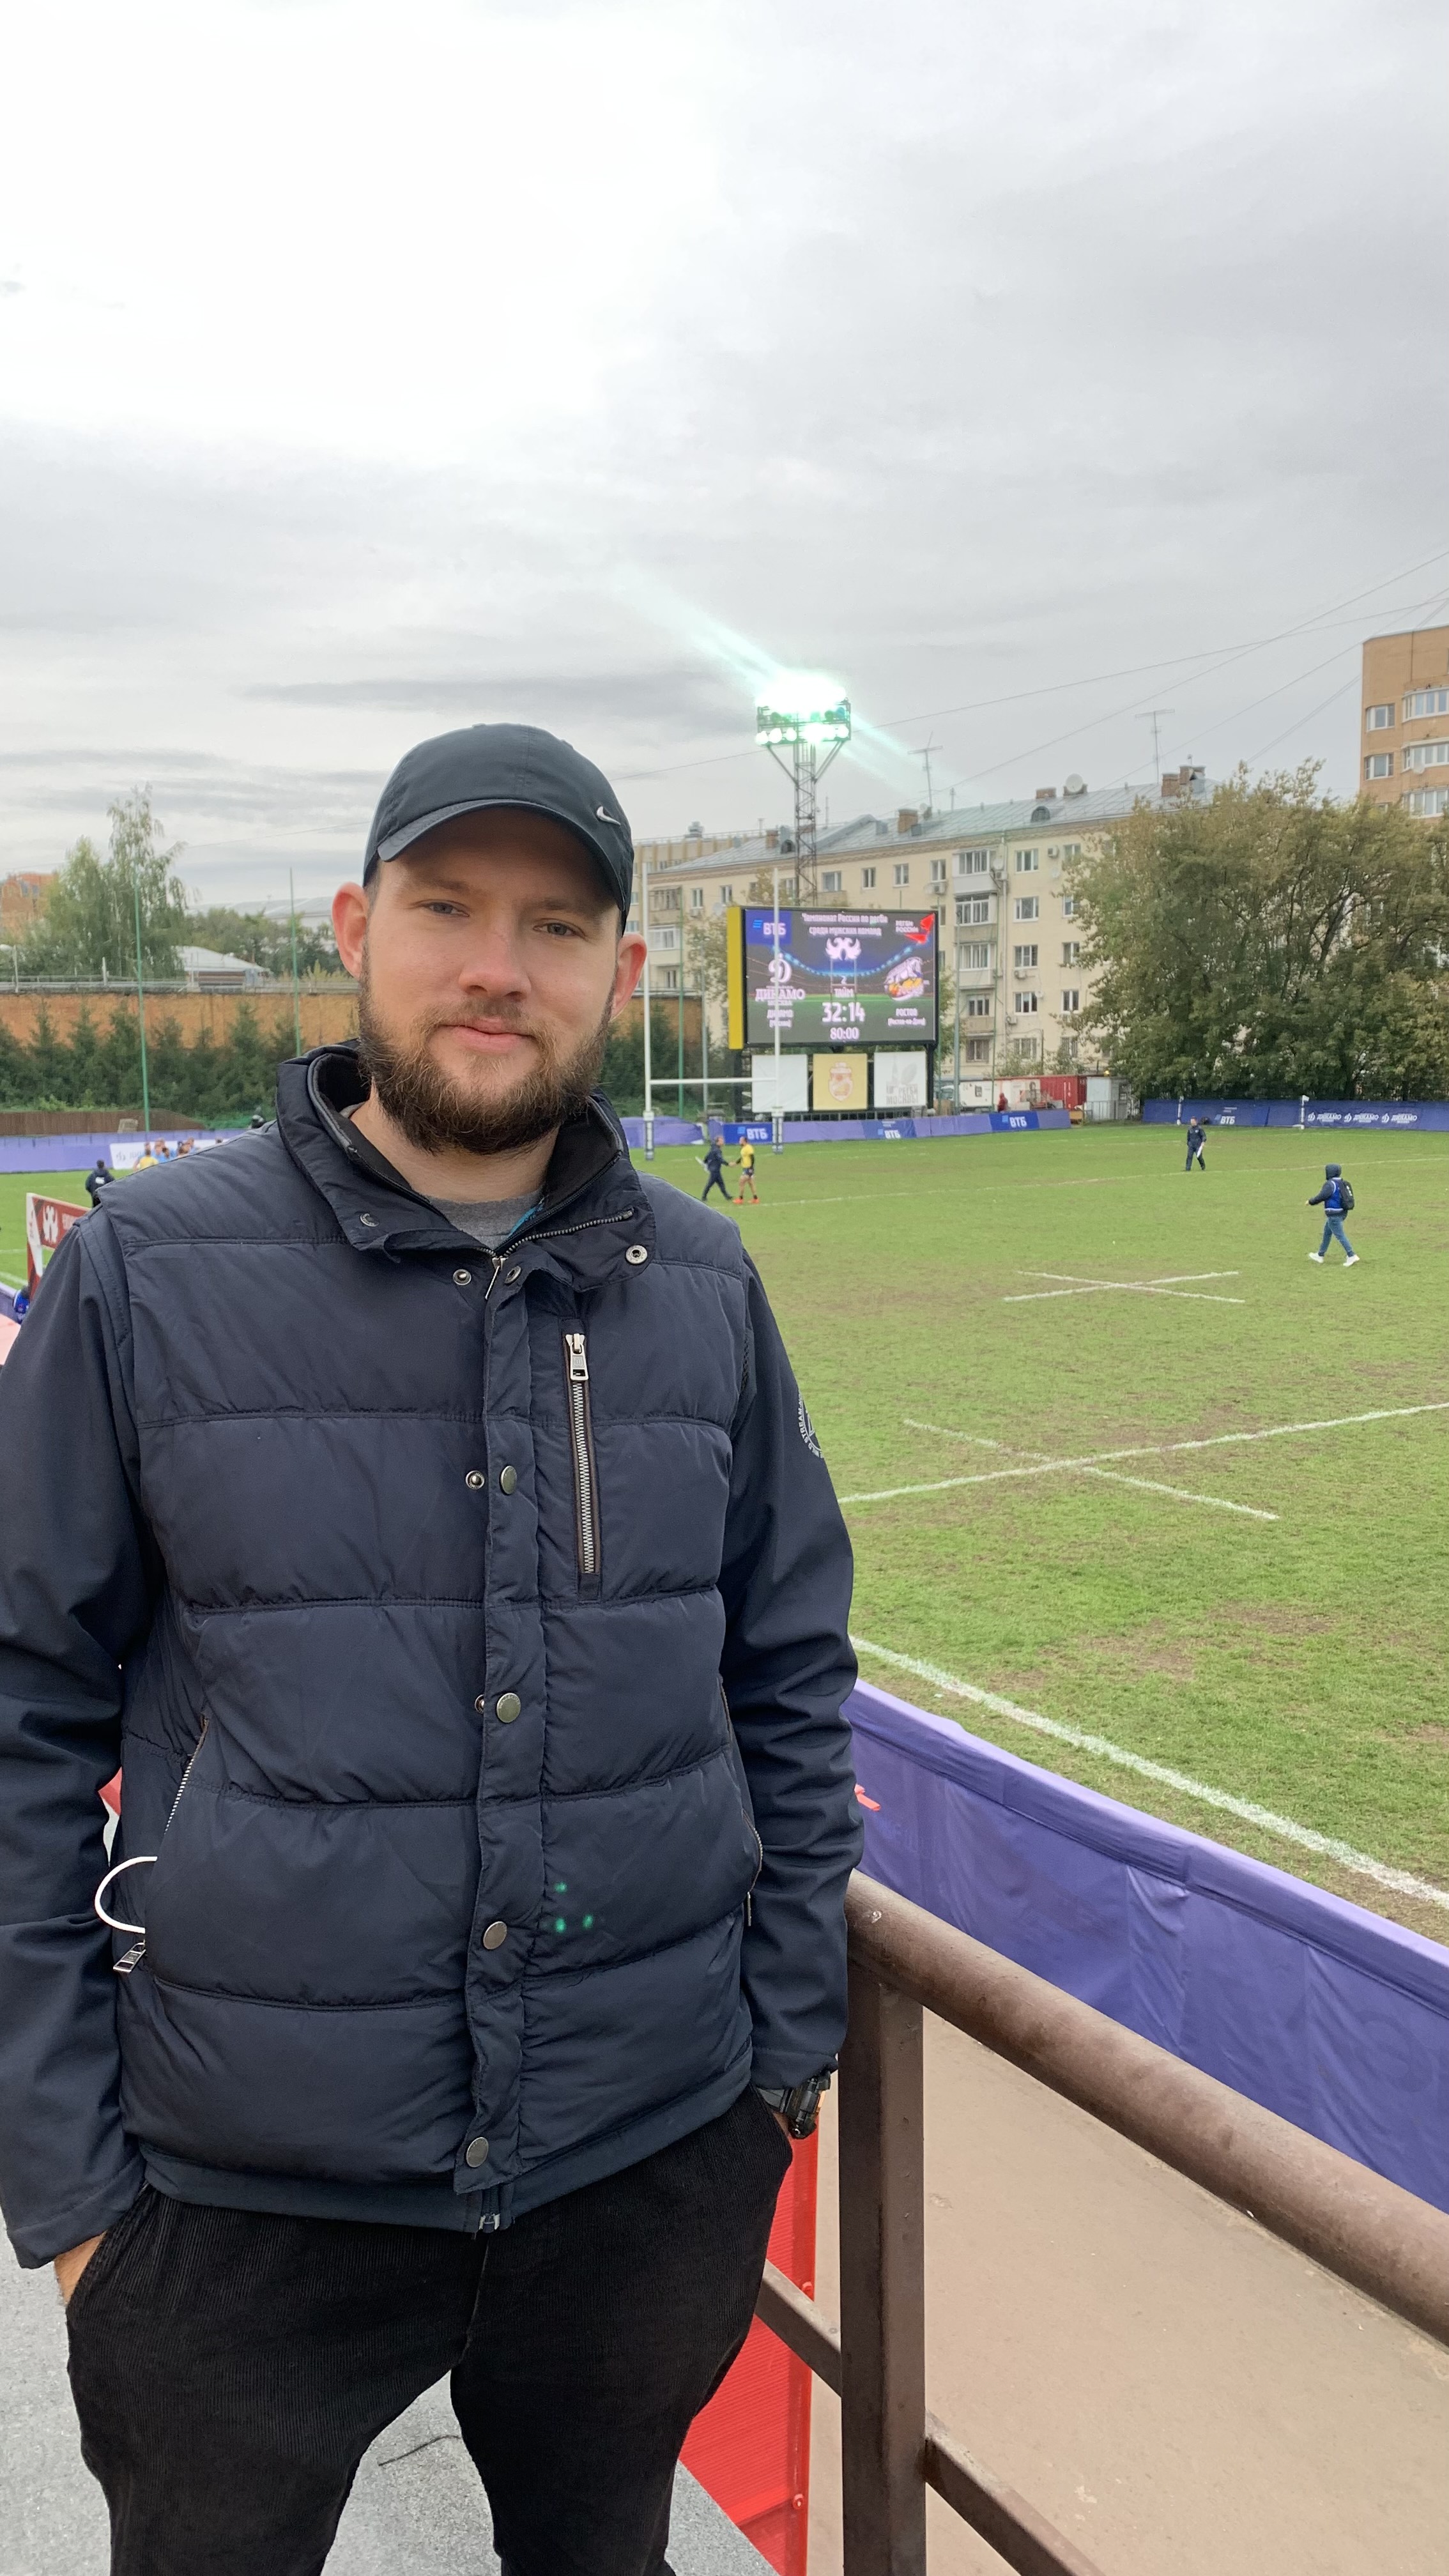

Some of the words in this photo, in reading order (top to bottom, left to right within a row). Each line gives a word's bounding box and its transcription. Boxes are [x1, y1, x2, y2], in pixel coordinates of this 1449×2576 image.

[841, 976, 847, 984] 2
[822, 1002, 865, 1022] 32:14
[831, 1027, 859, 1040] 80:00
[1009, 1117, 1027, 1128] ВТБ
[1220, 1116, 1236, 1124] ВТБ
[746, 1128, 768, 1140] ВТБ
[884, 1130, 901, 1139] ВТБ
